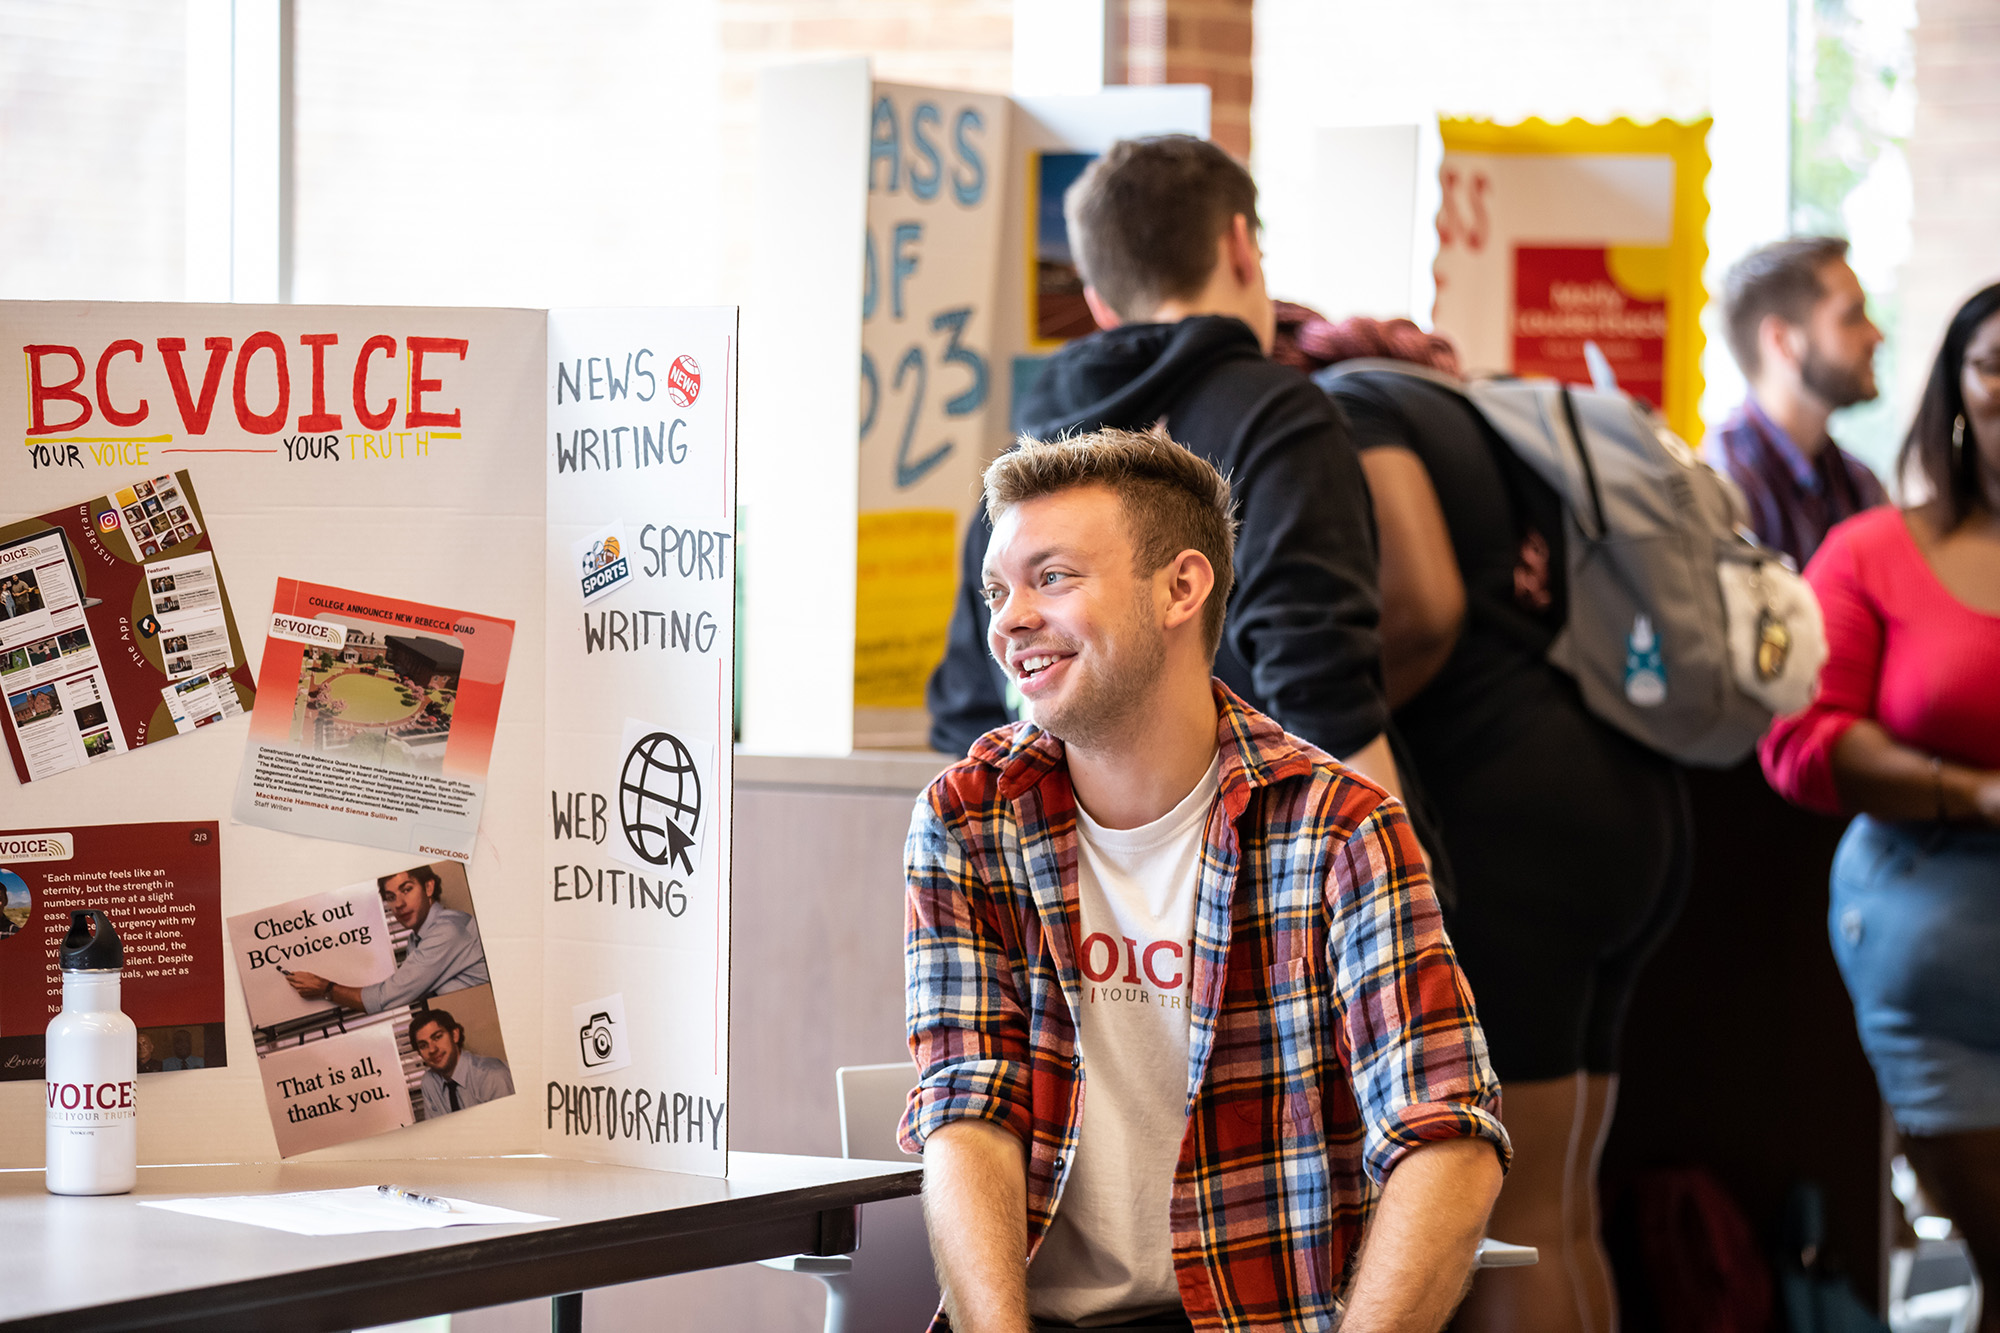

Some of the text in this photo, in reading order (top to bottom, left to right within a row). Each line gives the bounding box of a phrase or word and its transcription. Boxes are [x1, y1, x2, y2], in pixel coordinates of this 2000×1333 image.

[869, 94, 987, 207] ASS
[557, 348, 656, 406] NEWS
[668, 364, 699, 398] NEWS
[28, 431, 429, 470] YOUR VOICE YOUR TRUTH
[556, 418, 688, 474] WRITING
[80, 505, 115, 566] Instagram
[639, 523, 732, 581] SPORT
[147, 565, 170, 574] Features
[582, 561, 629, 596] SPORTS
[274, 618, 329, 638] BCVOICE
[308, 596, 475, 635] COLLEGE ANNOUNCES NEW REBECCA QUAD
[583, 609, 718, 655] WRITING
[119, 617, 145, 668] The App
[254, 800, 292, 812] Staff Writers
[255, 791, 294, 804] Mackenzie
[294, 798, 329, 810] Hammack
[345, 806, 369, 816] Sienna
[370, 811, 398, 821] Sullivan
[551, 789, 608, 845] WEB
[194, 832, 207, 842] 2/3
[419, 845, 469, 860] BCVOICE.ORG
[42, 868, 165, 883] "Each minute feels like an
[42, 880, 174, 896] eternity, but the strength in
[553, 864, 688, 919] EDITING
[44, 897, 86, 908] numbers
[88, 896, 109, 907] puts
[128, 894, 138, 902] at
[148, 892, 174, 903] slight
[44, 912, 69, 920] ease.
[111, 907, 131, 916] that
[138, 905, 167, 914] would
[169, 903, 196, 913] much
[119, 918, 156, 930] urgency
[158, 917, 179, 926] with
[181, 917, 196, 926] my
[123, 932, 143, 940] face
[145, 931, 152, 939] it
[154, 930, 183, 939] alone.
[253, 900, 354, 941] Check out
[126, 954, 193, 966] silent. Despite
[137, 942, 169, 952] sound,
[171, 942, 187, 950] the
[246, 923, 372, 970] BCvoice.org
[1080, 932, 1192, 990] OIC
[162, 967, 177, 976] act
[1100, 987, 1150, 1004] YOUR
[276, 1056, 382, 1100] That is all,
[47, 1081, 132, 1110] VOICE
[287, 1086, 390, 1124] thank you.
[70, 1112, 100, 1121] YOUR
[104, 1111, 132, 1120] TRUTH
[547, 1080, 726, 1151] PHOTOGRAPHY
